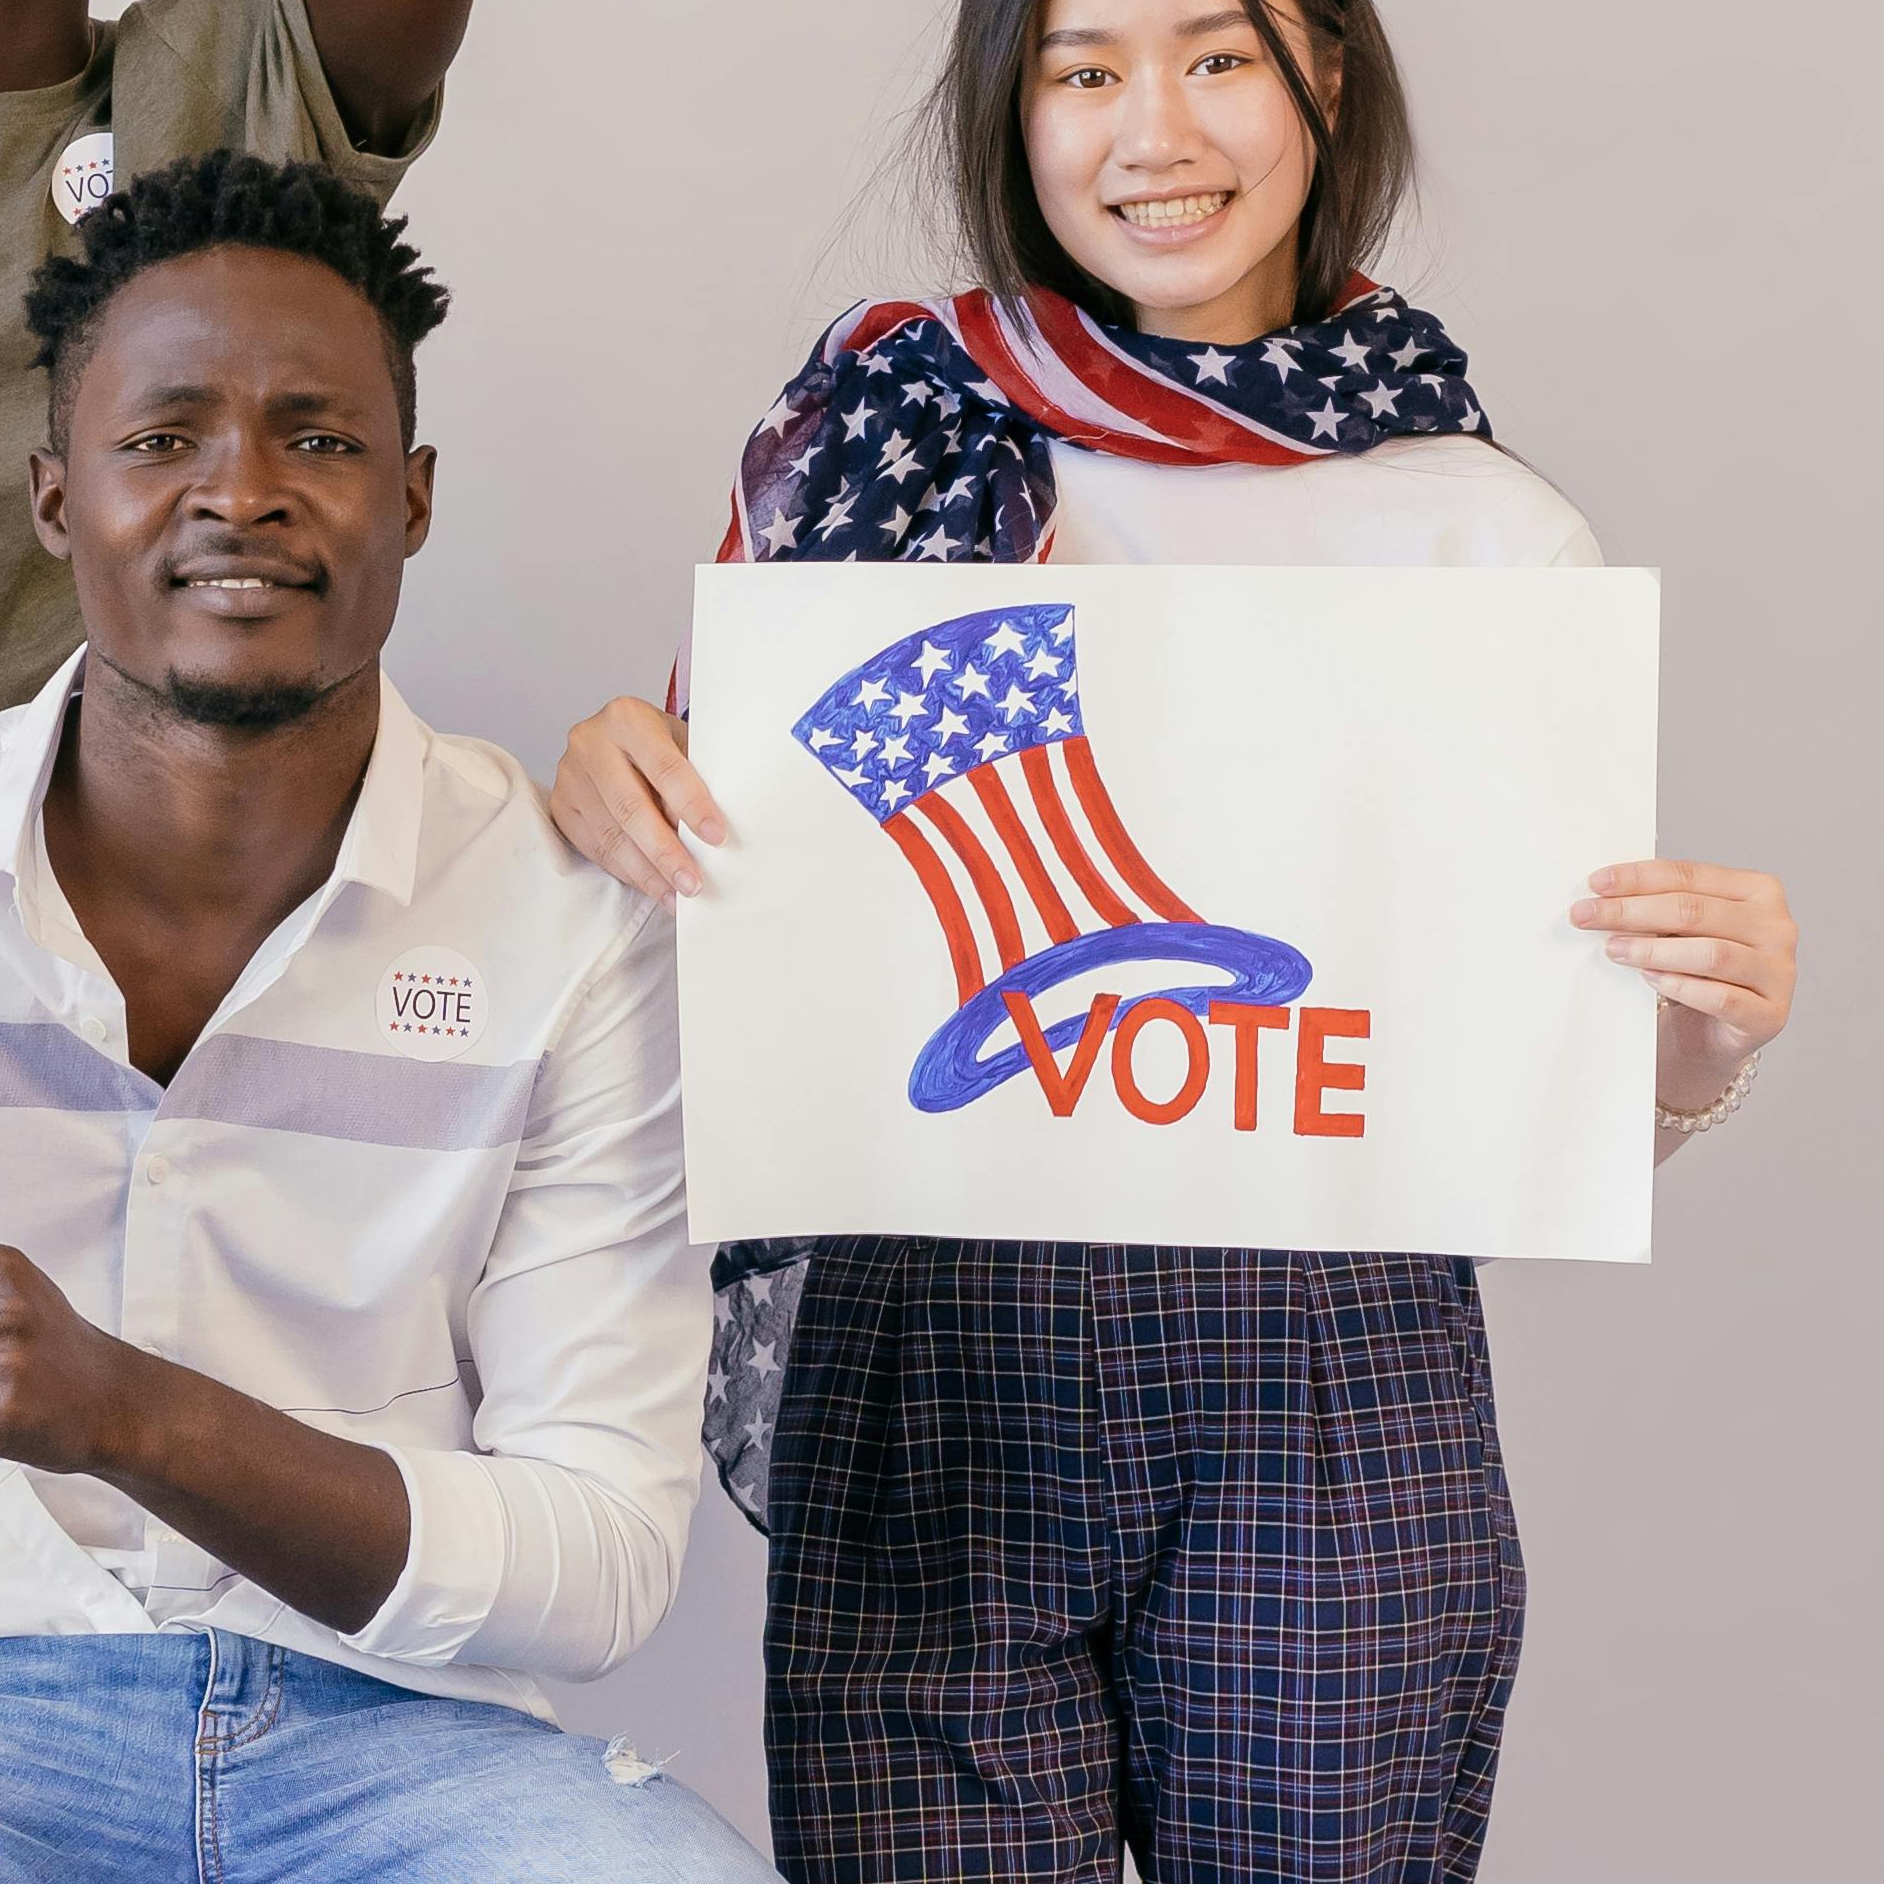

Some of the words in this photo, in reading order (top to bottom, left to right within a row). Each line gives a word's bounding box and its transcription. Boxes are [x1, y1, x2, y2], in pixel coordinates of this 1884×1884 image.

[65, 169, 114, 203] VO
[392, 986, 472, 1023] VOTE
[1002, 990, 1371, 1138] VOTE
